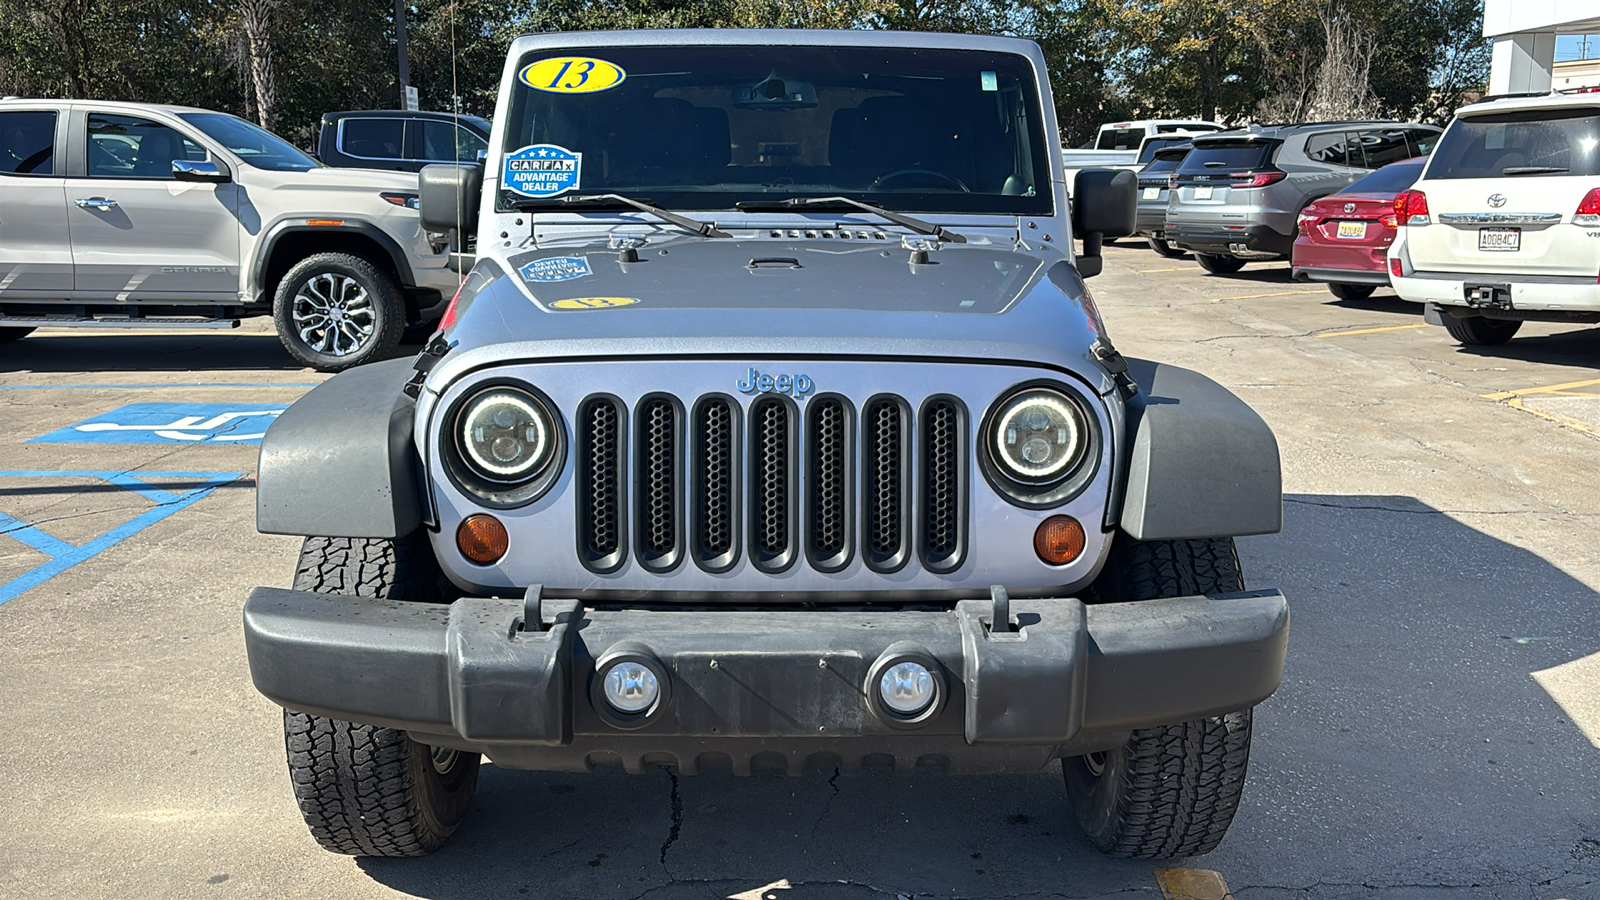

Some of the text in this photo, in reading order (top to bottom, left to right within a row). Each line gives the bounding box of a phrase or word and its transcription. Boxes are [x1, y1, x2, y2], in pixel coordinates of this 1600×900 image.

[544, 61, 595, 88] 13
[510, 160, 573, 171] CARFAX
[513, 172, 570, 182] ADVANTAGE
[522, 182, 558, 191] DEALER
[735, 368, 811, 398] Jeep
